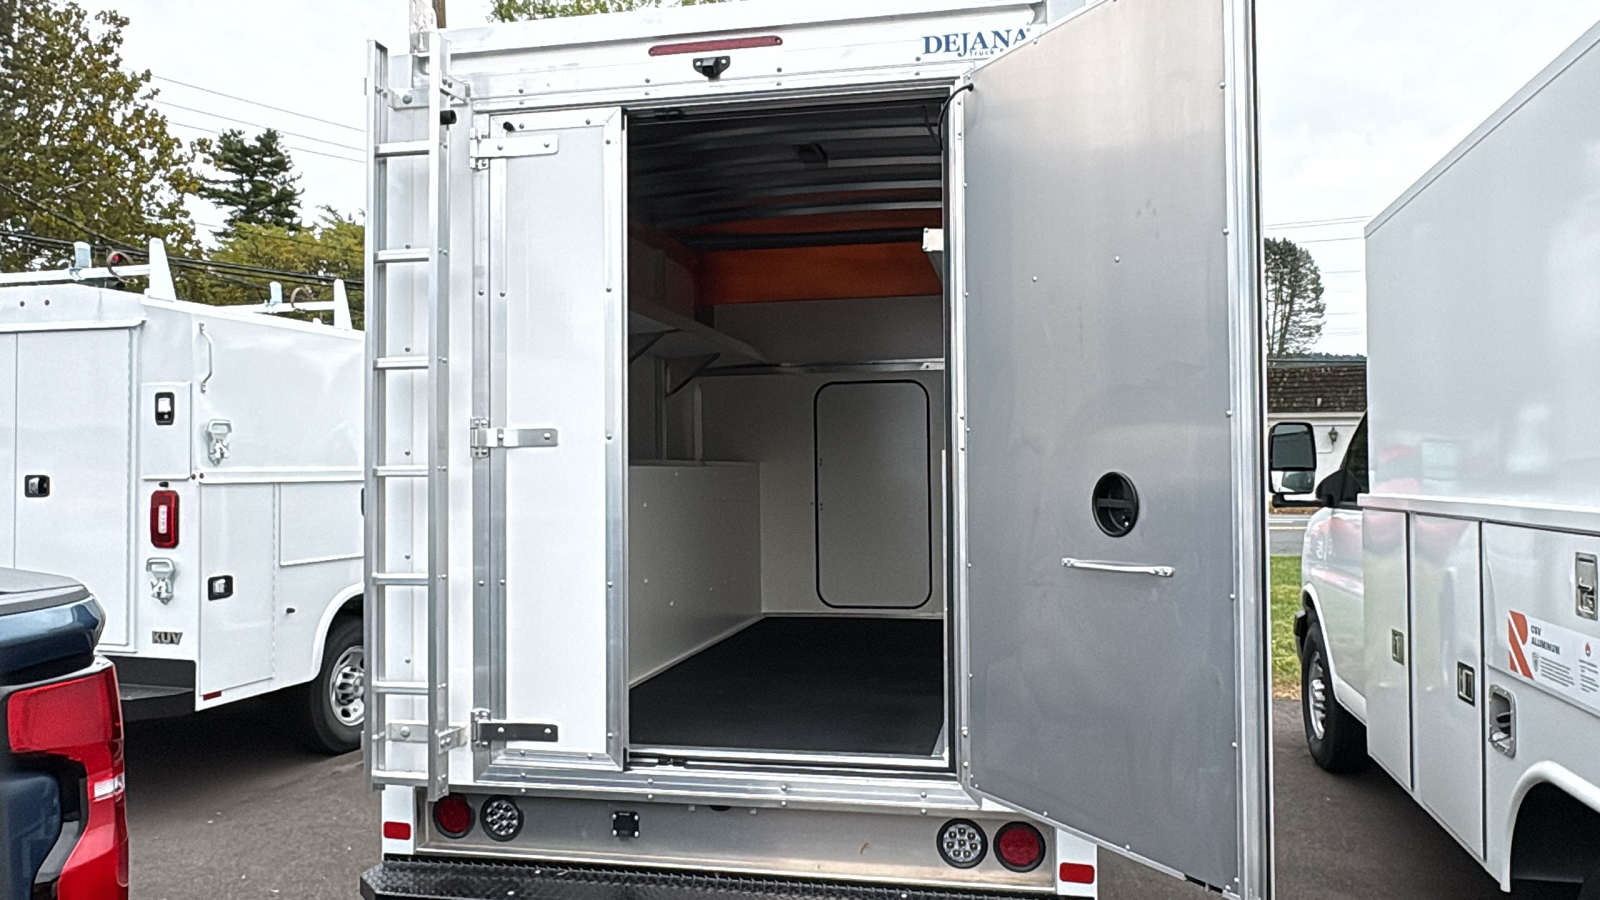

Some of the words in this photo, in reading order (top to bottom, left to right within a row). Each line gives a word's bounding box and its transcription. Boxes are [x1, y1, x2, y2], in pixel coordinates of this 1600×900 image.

[921, 28, 1026, 57] DEJANA
[151, 630, 183, 645] KUV
[1531, 636, 1561, 655] ALUMINUM
